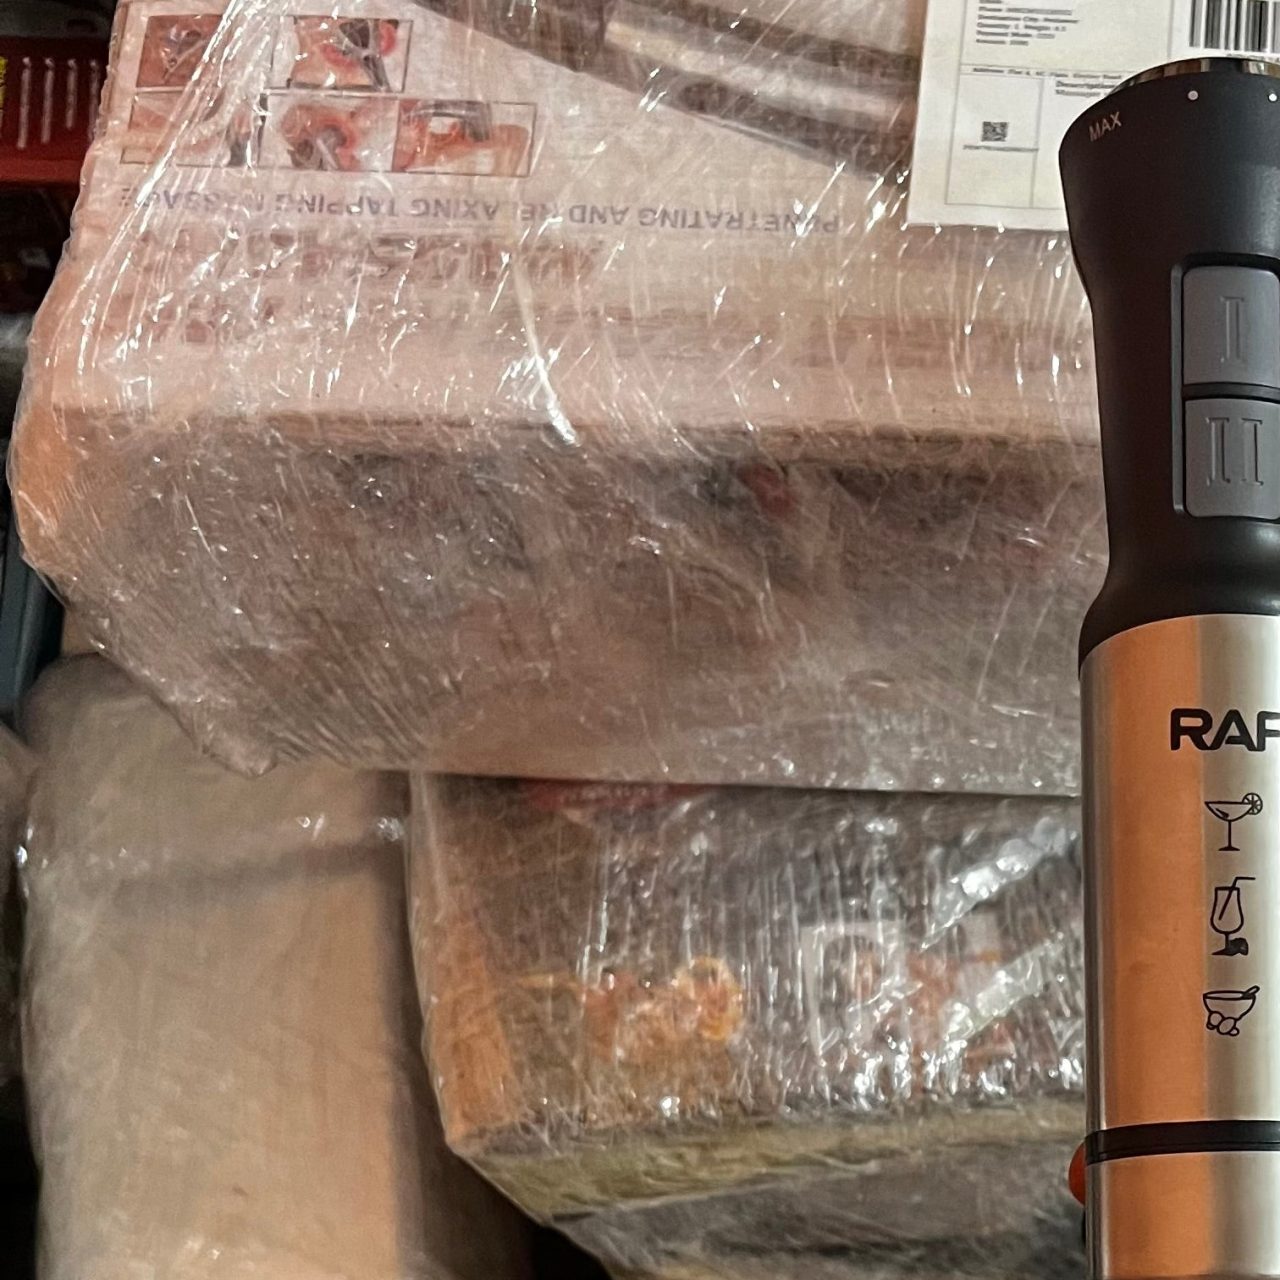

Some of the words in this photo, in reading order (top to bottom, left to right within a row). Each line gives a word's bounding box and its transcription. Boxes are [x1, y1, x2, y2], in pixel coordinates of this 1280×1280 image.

[1088, 111, 1122, 142] MAX
[568, 203, 629, 225] AND
[639, 202, 840, 232] PNETRATING
